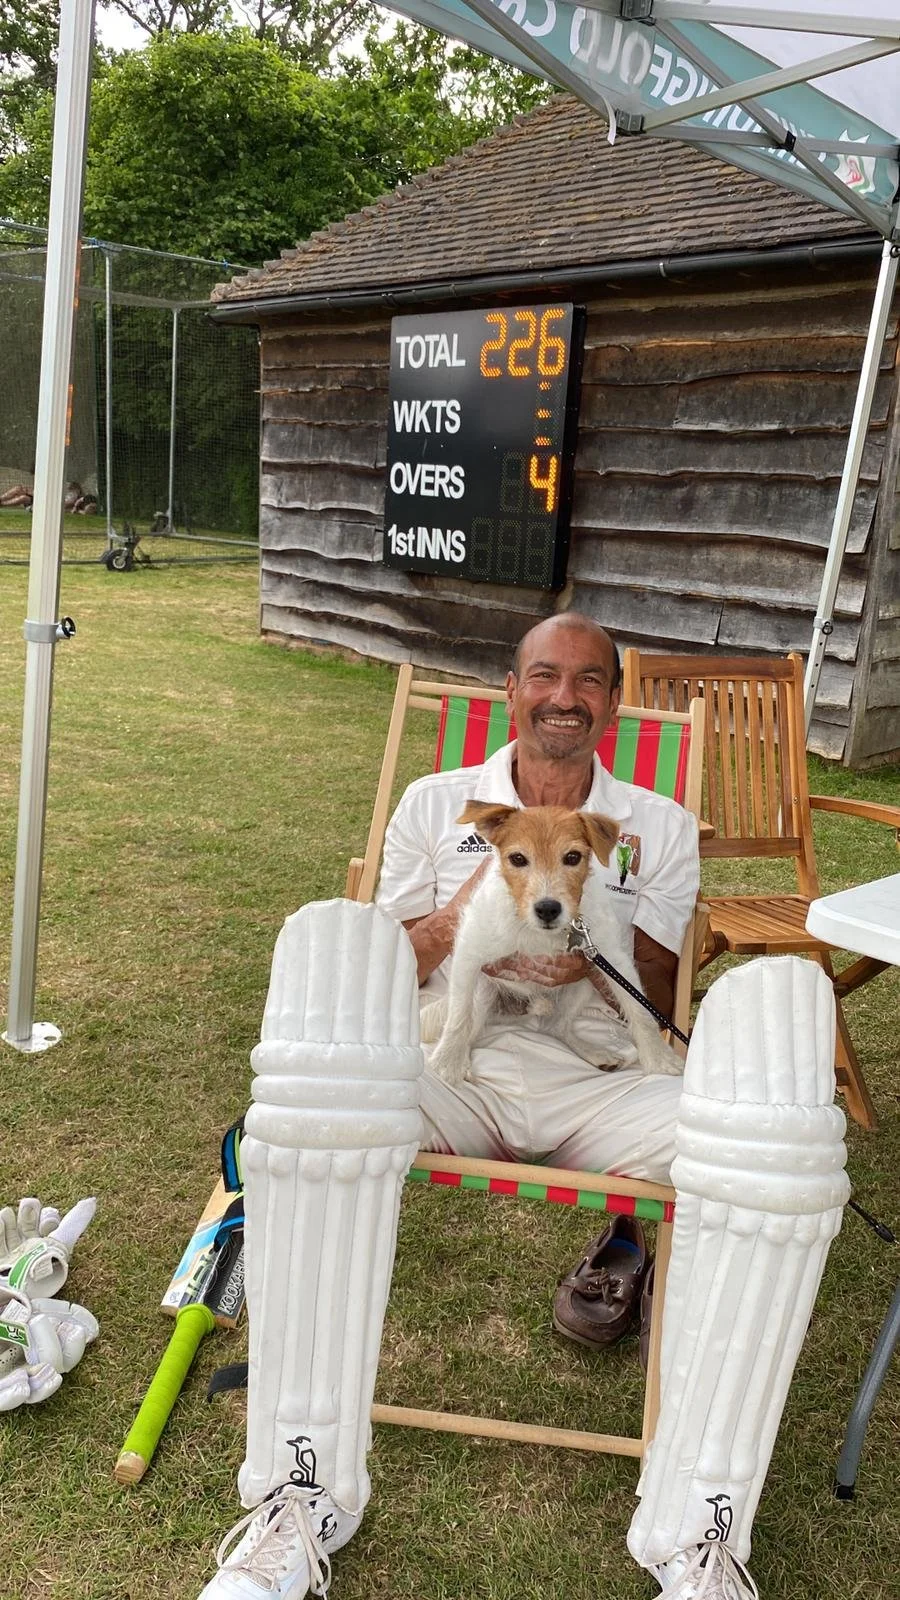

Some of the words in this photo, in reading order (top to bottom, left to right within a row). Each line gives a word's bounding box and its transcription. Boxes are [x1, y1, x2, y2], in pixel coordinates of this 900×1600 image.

[395, 333, 466, 369] TOTAL
[479, 308, 566, 377] 226
[393, 399, 461, 434] WKTS
[390, 461, 466, 499] OVERS
[529, 454, 558, 513] 4
[387, 523, 415, 557] 1st
[416, 526, 466, 563] INNS
[457, 844, 493, 853] adidas
